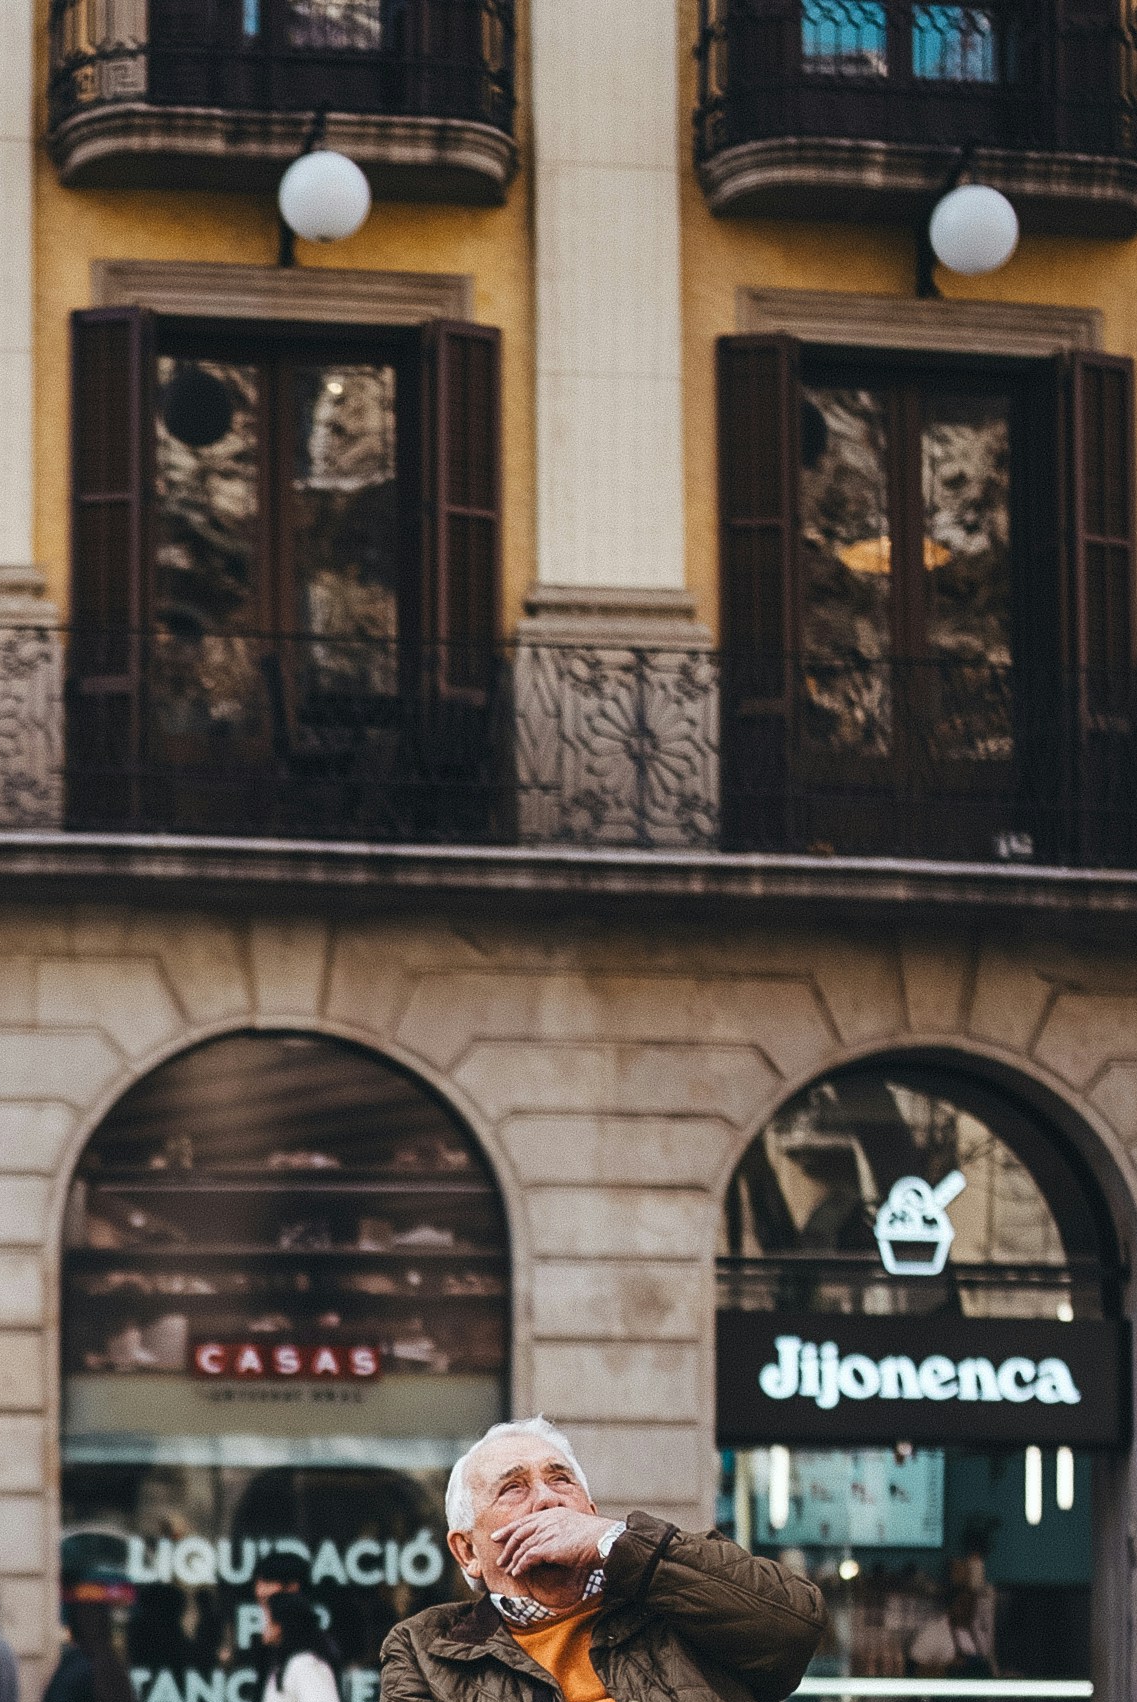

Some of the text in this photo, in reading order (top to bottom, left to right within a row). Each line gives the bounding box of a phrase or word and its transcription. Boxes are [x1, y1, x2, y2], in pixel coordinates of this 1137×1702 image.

[196, 1344, 378, 1376] CASAS
[759, 1335, 1081, 1409] Jijonenca
[126, 1529, 444, 1586] LIQUACIÓ
